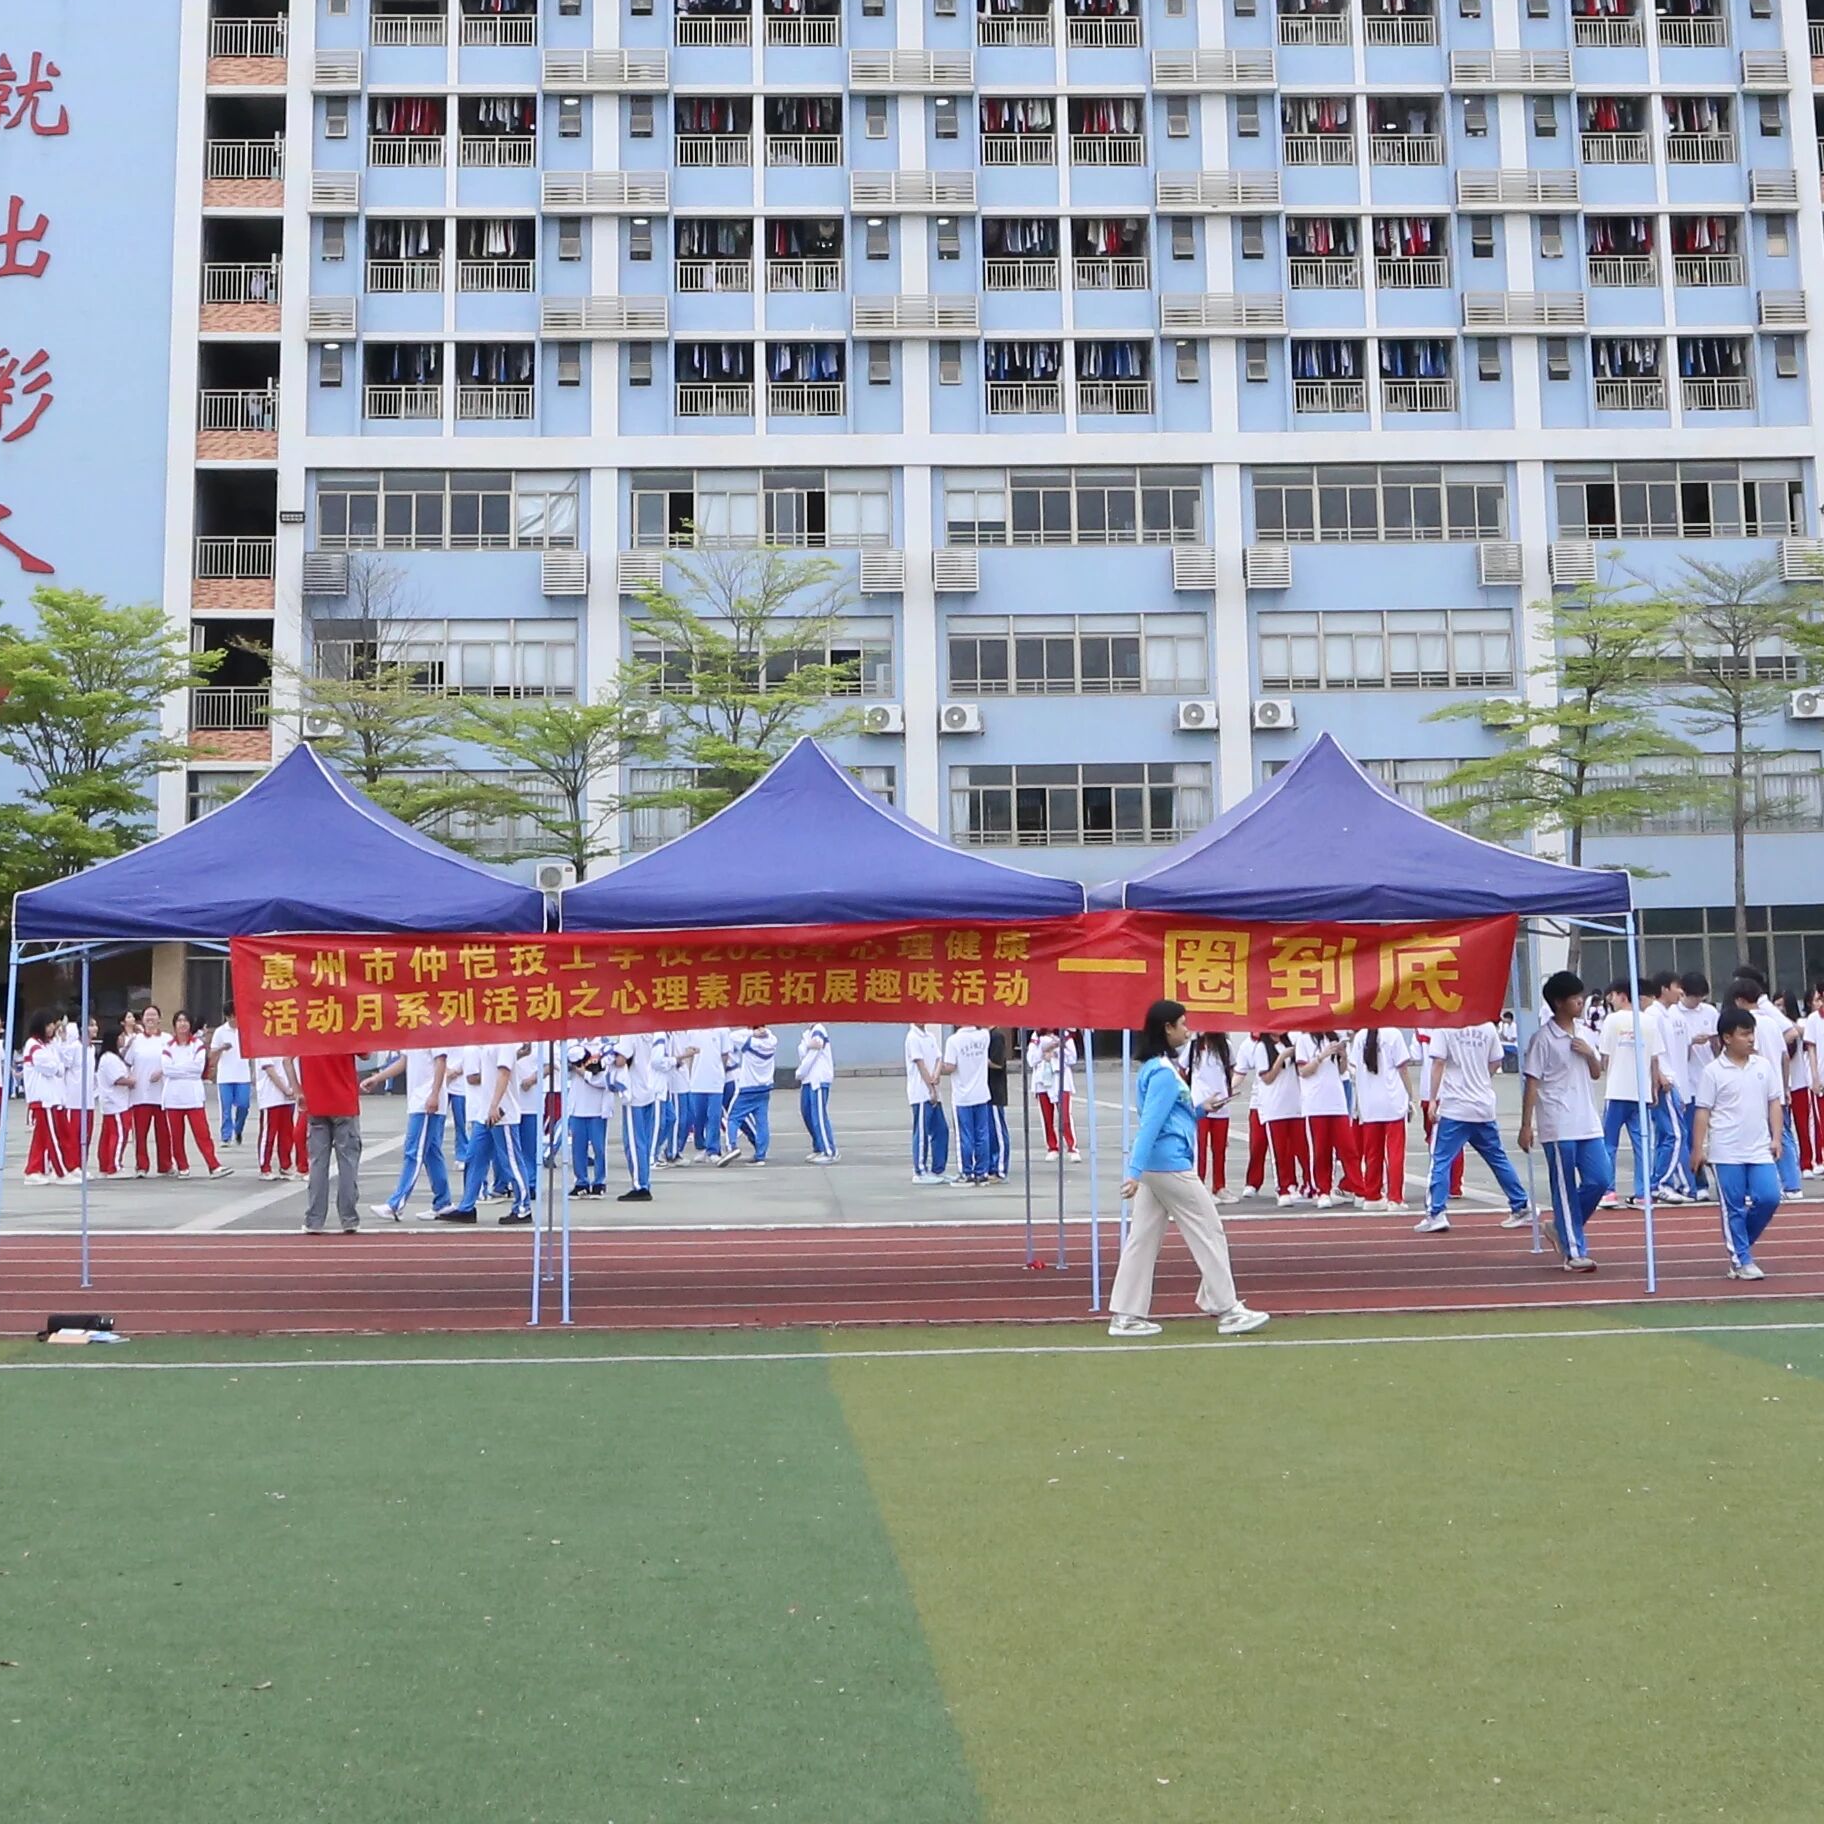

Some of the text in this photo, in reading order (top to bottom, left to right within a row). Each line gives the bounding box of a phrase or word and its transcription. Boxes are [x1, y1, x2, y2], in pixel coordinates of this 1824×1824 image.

[261, 967, 1030, 1037] 活动月系列活动之心理素质拓展趣味活动
[1057, 928, 1465, 1016] 一圈到底
